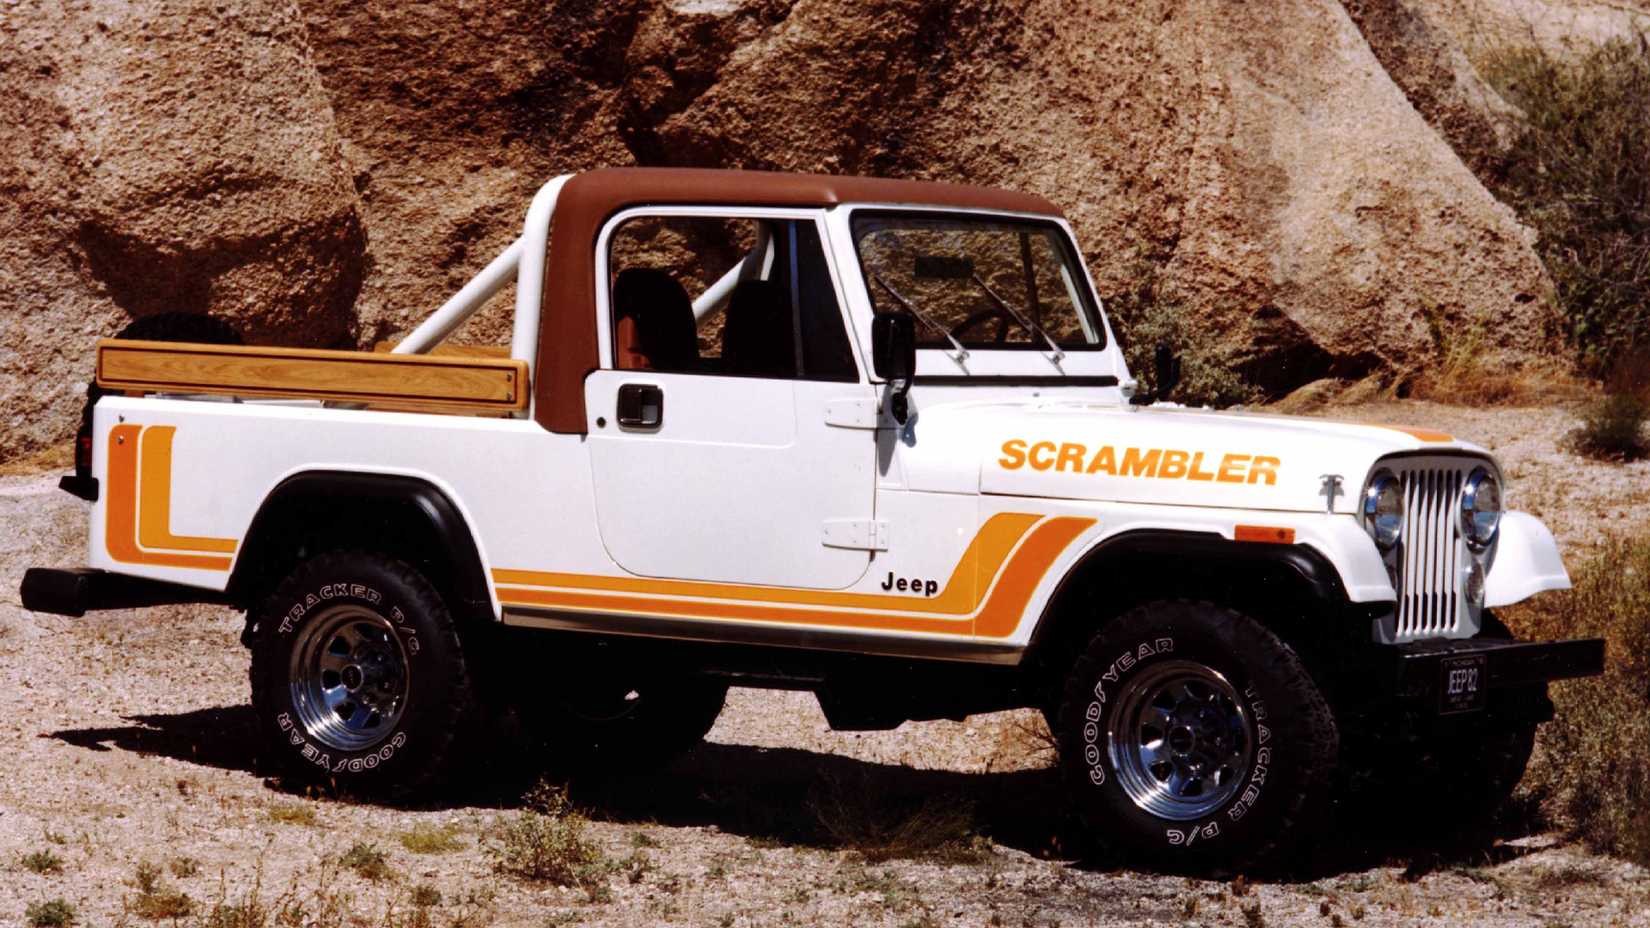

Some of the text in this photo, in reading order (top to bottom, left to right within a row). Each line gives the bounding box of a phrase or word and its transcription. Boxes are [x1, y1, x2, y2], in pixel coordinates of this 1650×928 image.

[999, 439, 1281, 486] SCRAMBLER
[278, 583, 382, 634] TRACKER
[881, 572, 938, 595] Jeep
[1084, 637, 1174, 785] GOODYEAR
[277, 712, 407, 772] GOODYEAR
[1228, 681, 1271, 821] TRACKER
